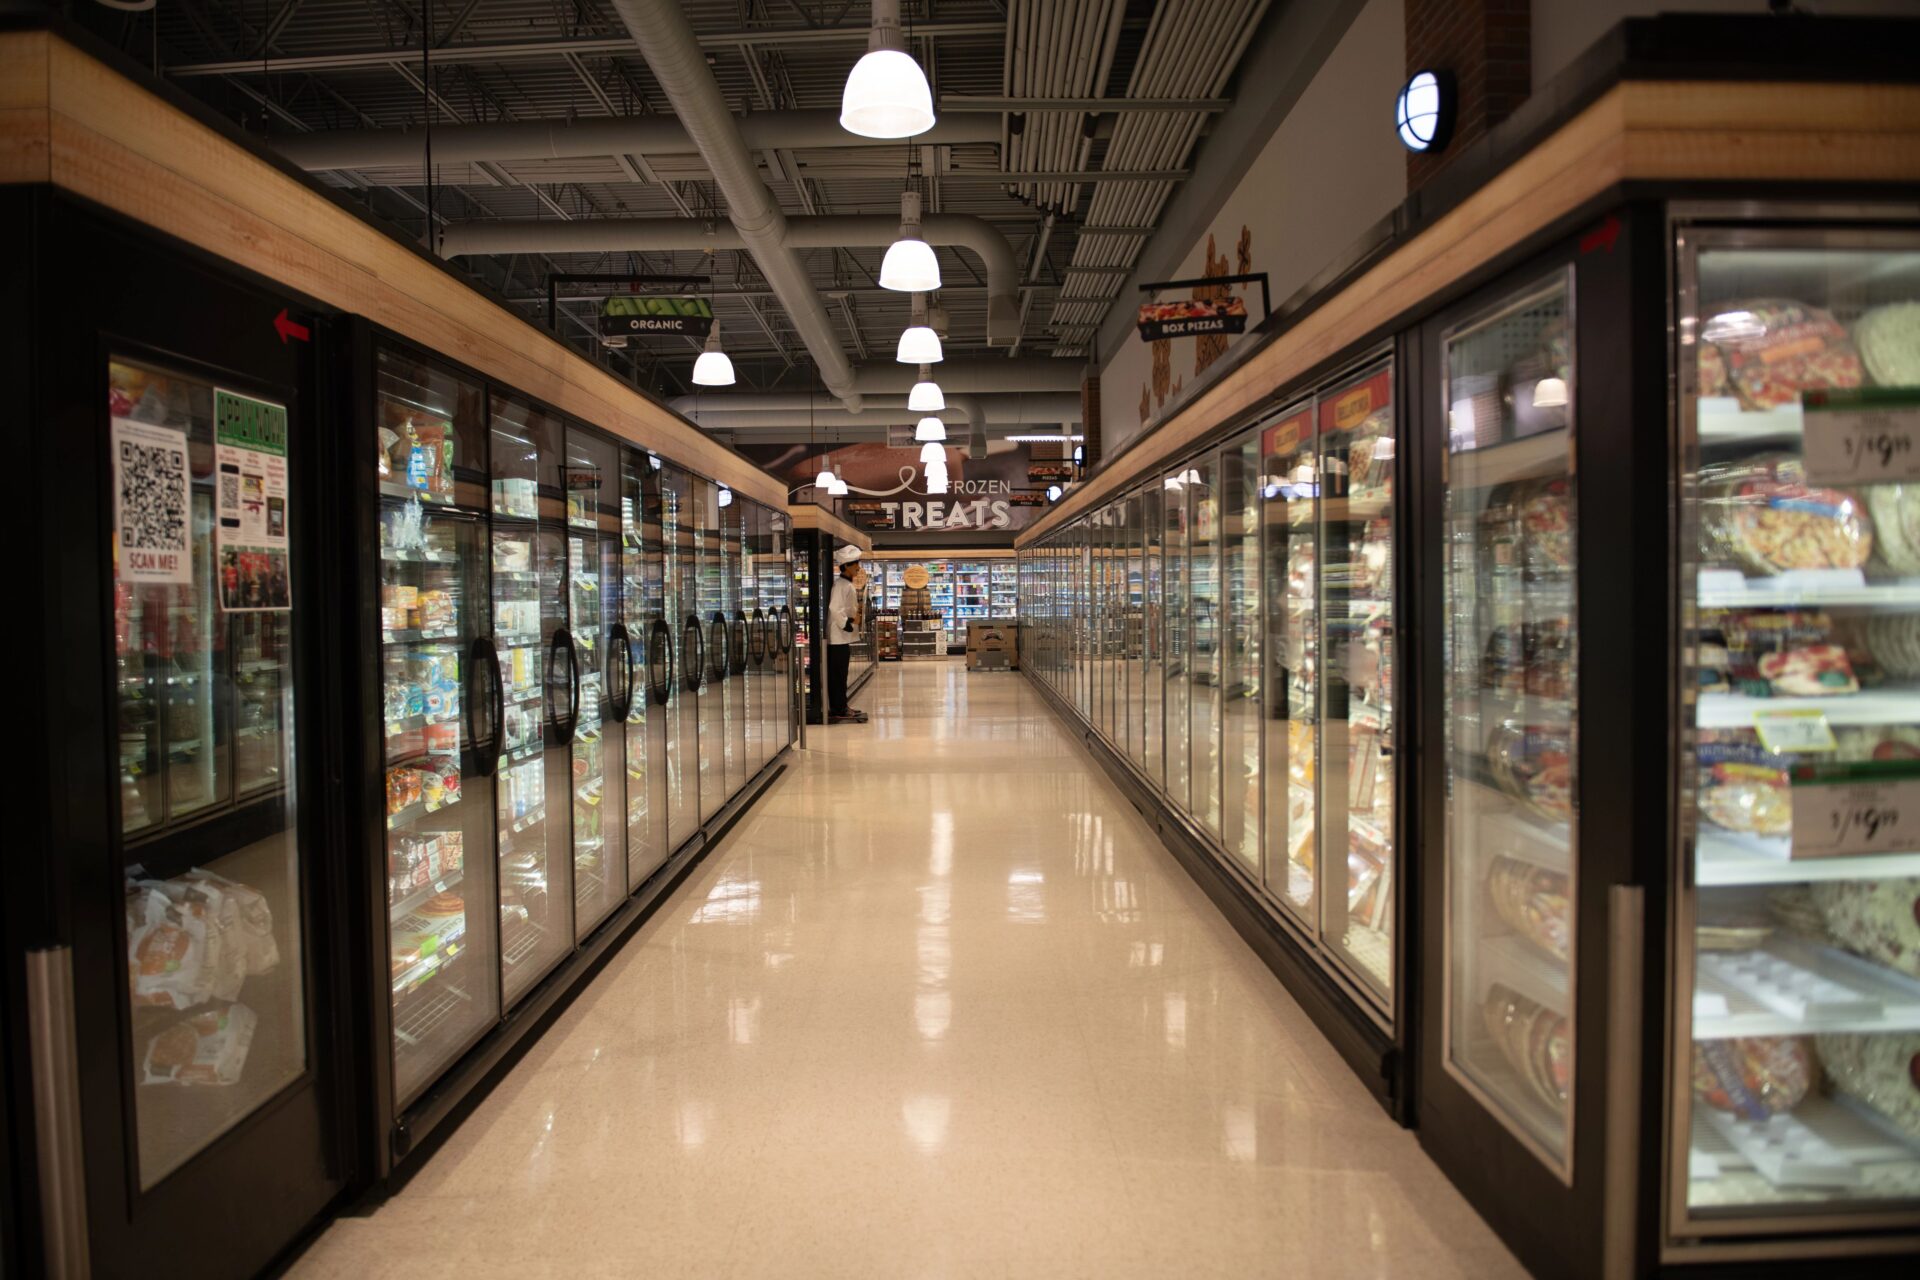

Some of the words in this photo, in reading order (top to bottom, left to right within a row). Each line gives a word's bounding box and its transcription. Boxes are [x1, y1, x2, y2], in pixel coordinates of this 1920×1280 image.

[630, 320, 683, 329] ORGANIC
[1161, 322, 1185, 334] BOX
[1187, 319, 1224, 331] PIZZAS
[945, 479, 1010, 495] FROZEN
[880, 500, 1010, 529] TREATS
[129, 552, 155, 569] SCAN
[158, 554, 178, 570] ME!
